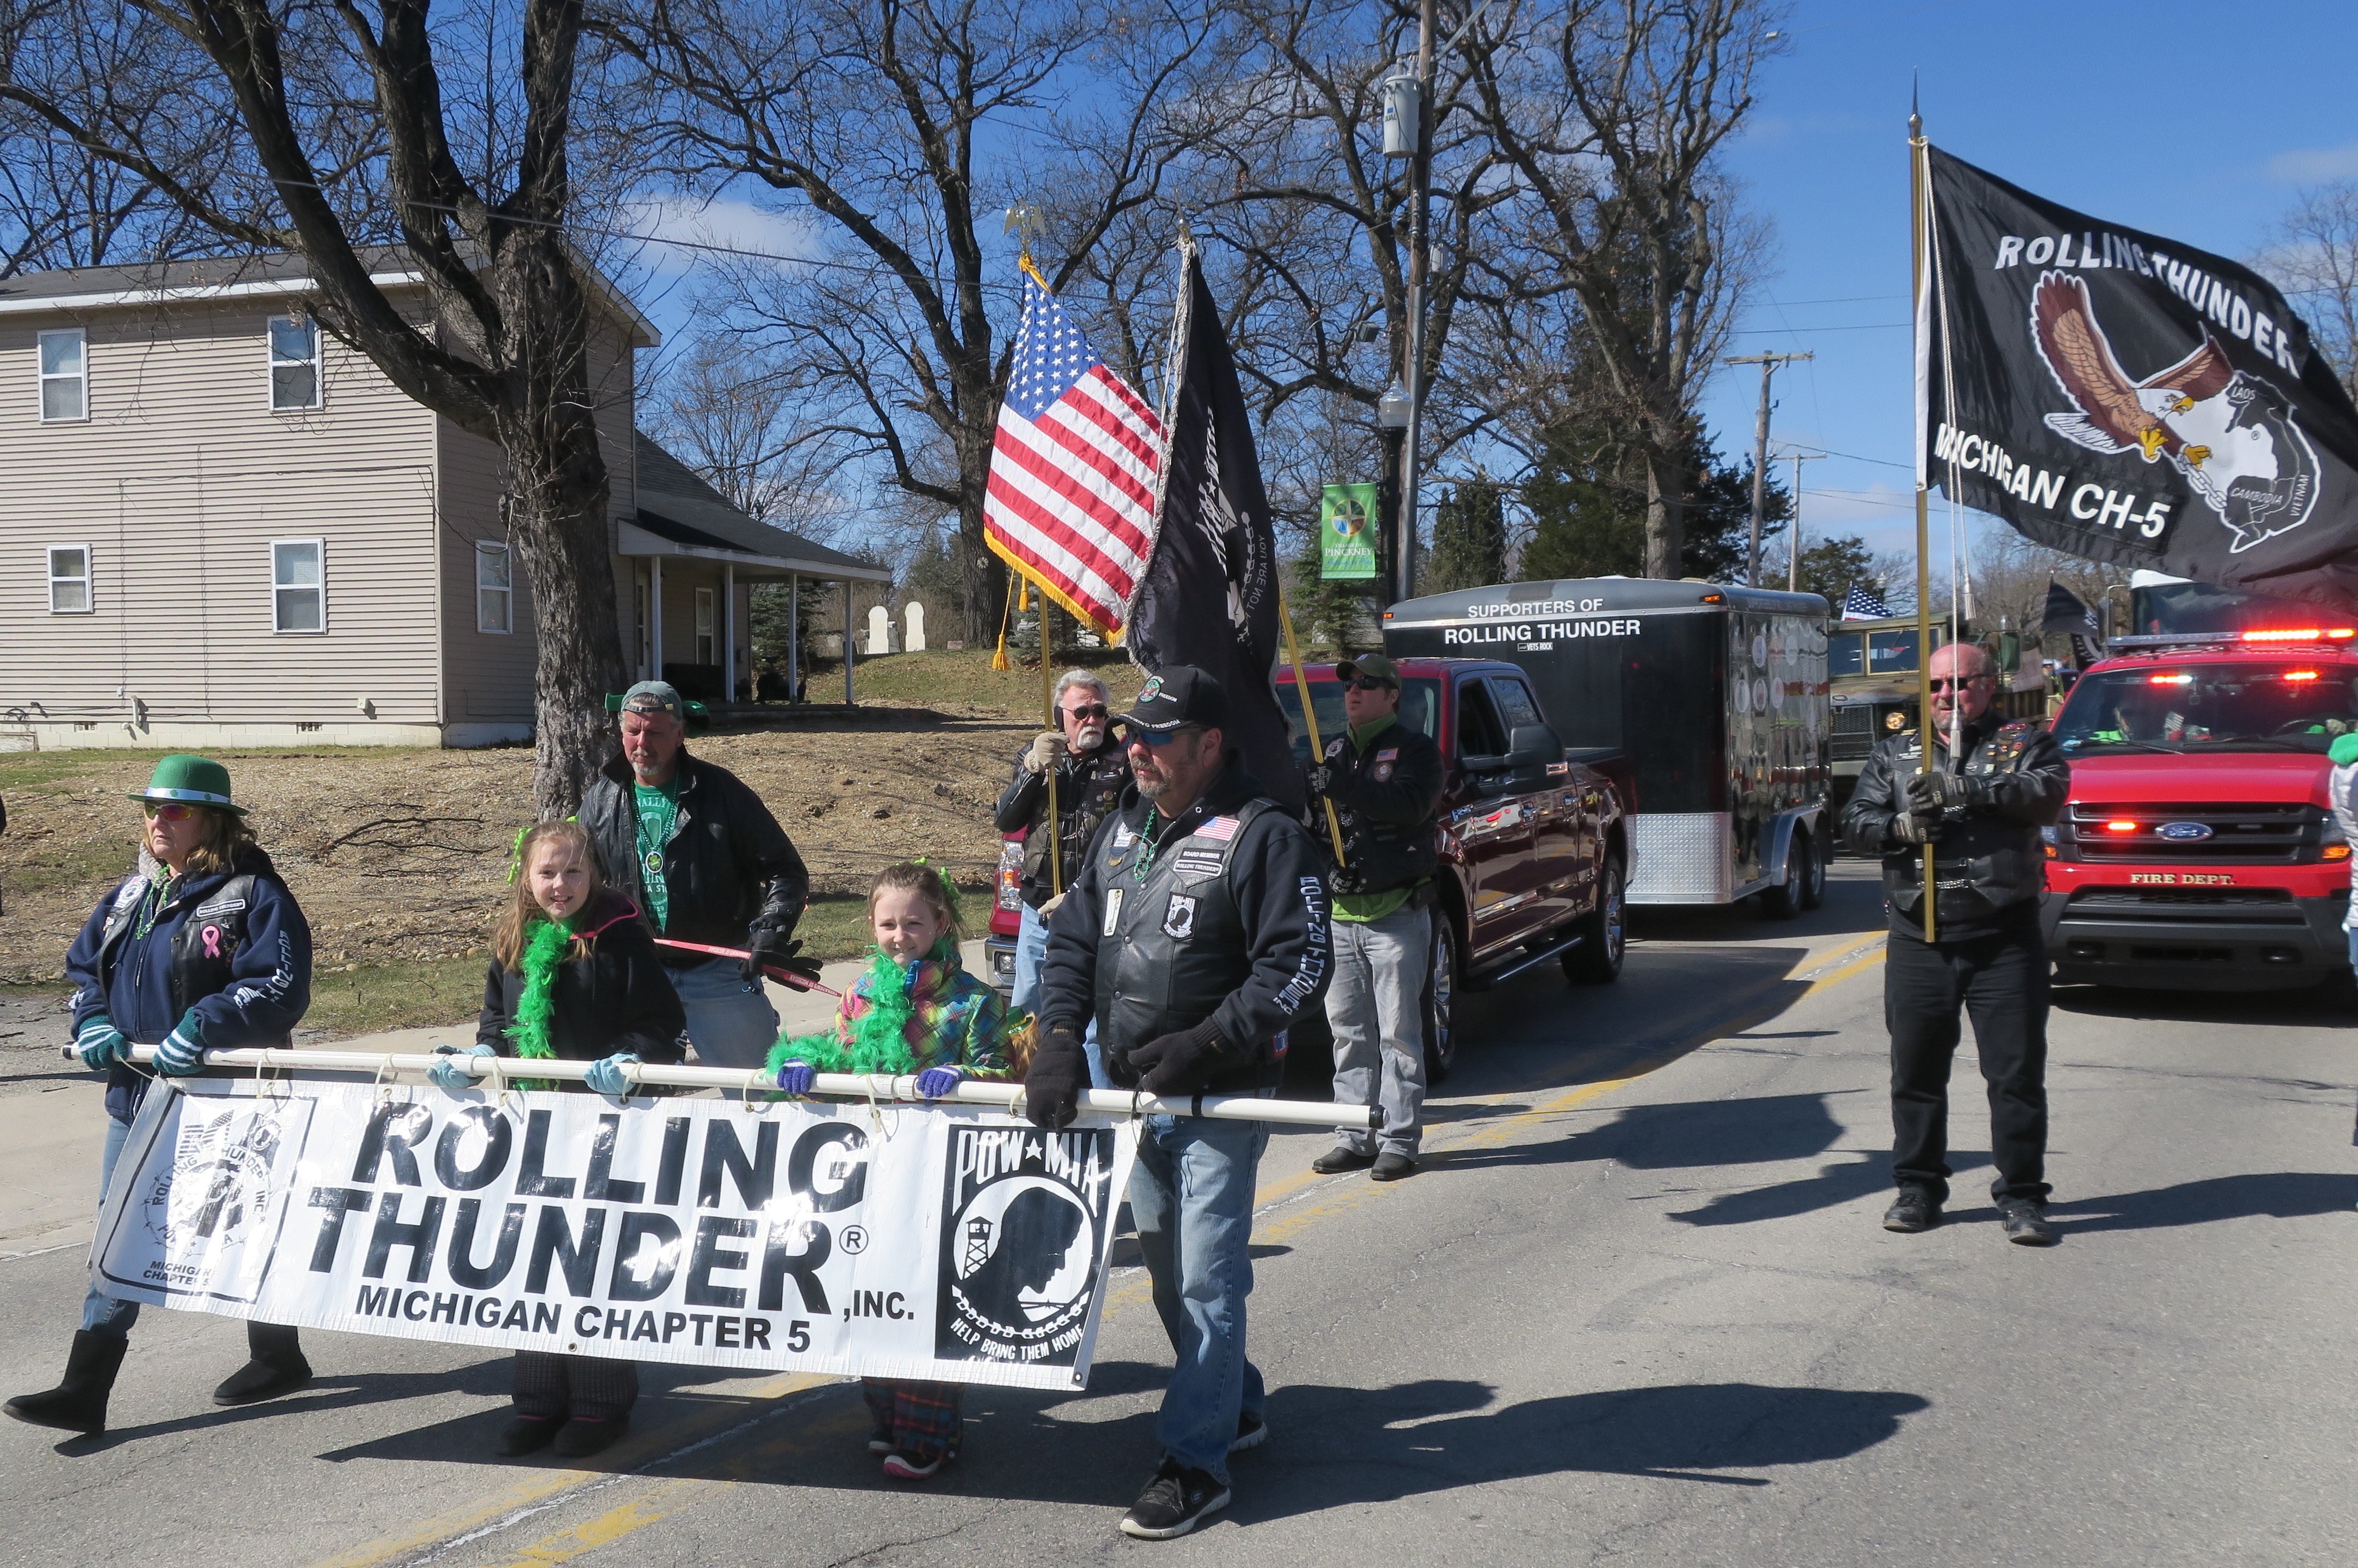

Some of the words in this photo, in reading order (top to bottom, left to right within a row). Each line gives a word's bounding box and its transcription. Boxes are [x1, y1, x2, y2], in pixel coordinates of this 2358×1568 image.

[1994, 232, 2153, 277] ROLLING
[2151, 252, 2301, 379] THUNDER
[2232, 386, 2256, 399] LAOS
[1934, 423, 2067, 510] MICHIGAN
[2070, 483, 2171, 538] CH-5
[2231, 487, 2283, 505] CAMBODIA
[2290, 474, 2310, 517] VIETNAM
[1325, 548, 1373, 557] PINCKNEY
[1468, 600, 1576, 618] SUPPORTERS
[1580, 598, 1603, 612] OF
[1445, 625, 1531, 644] ROLLING
[1537, 620, 1641, 639] THUNDER
[1526, 643, 1539, 651] VETS
[1539, 642, 1553, 650] ROCK
[1151, 719, 1181, 729] FREEDOM
[1200, 851, 1220, 860] MEMBER
[2131, 873, 2175, 884] FIRE
[2182, 874, 2235, 885] DEPT.
[1299, 876, 1327, 944] ROLLING
[352, 1101, 869, 1213] ROLLING
[951, 1129, 1026, 1217] POW
[1044, 1131, 1102, 1218] MIA
[307, 1186, 832, 1315] THUNDER
[356, 1284, 562, 1335] MICHIGAN
[573, 1305, 771, 1351] CHAPTER
[787, 1321, 811, 1353] 5
[950, 1317, 981, 1345] HELP
[980, 1338, 1016, 1360] BRING
[1020, 1341, 1050, 1360] THEM
[1052, 1323, 1083, 1352] HOME
